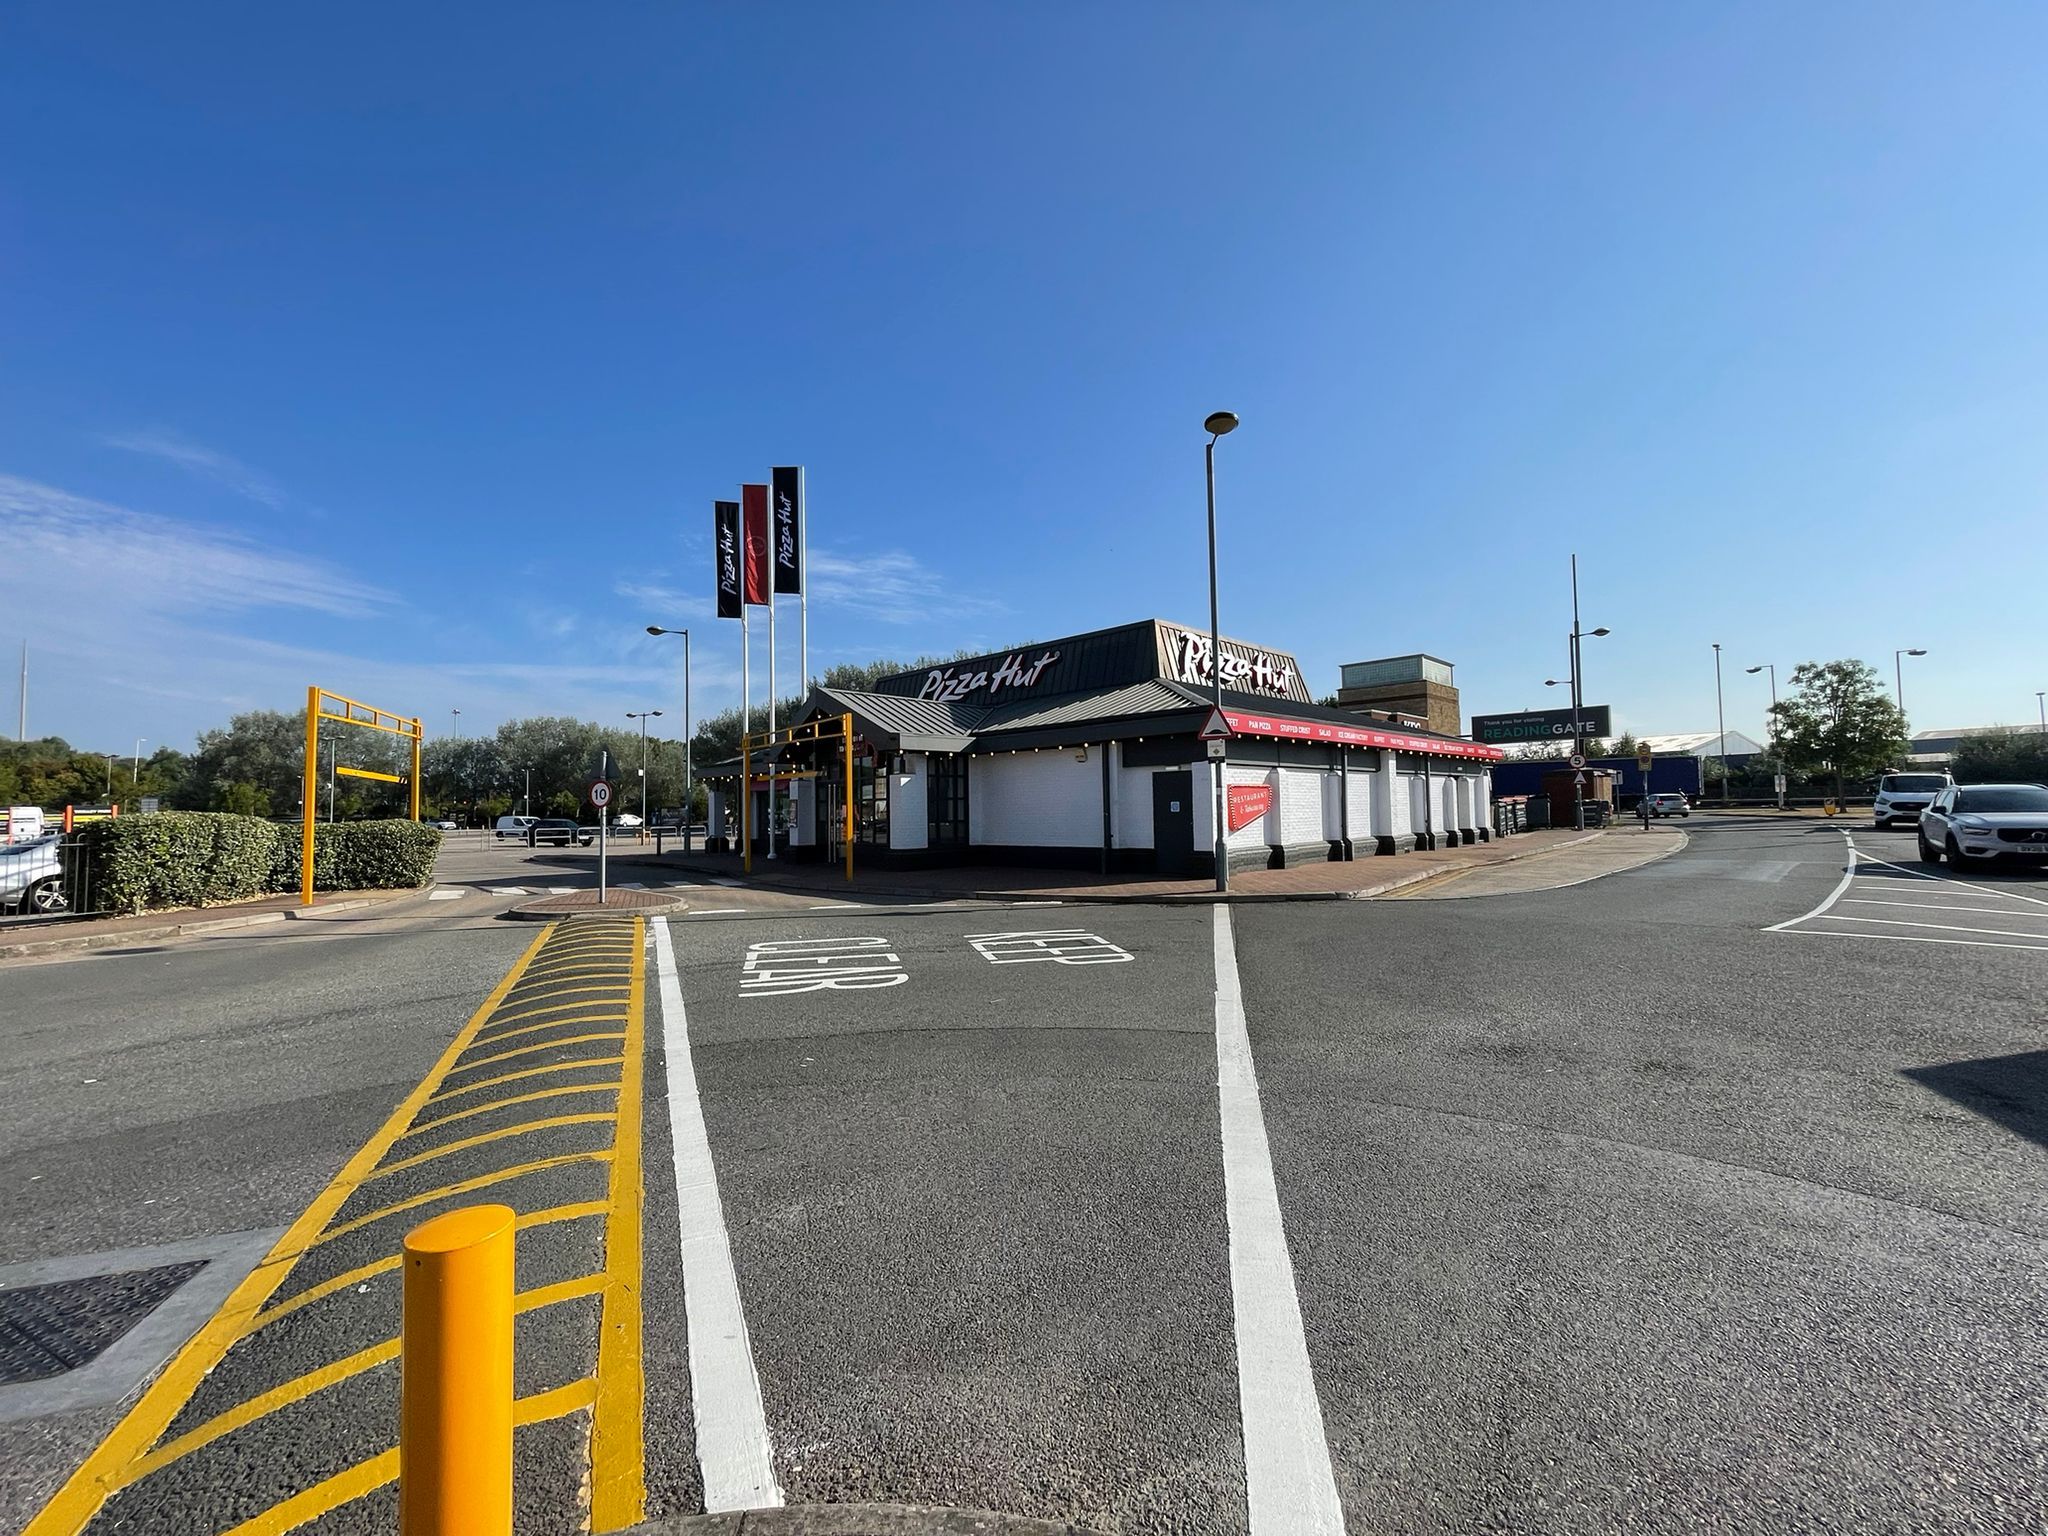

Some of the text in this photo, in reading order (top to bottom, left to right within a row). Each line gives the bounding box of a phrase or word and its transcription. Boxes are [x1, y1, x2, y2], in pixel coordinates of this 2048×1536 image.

[777, 491, 795, 569] Pizza Hut
[720, 523, 737, 595] Pizza Hut
[918, 651, 1057, 701] Pizza Hut
[1180, 631, 1296, 694] Pizza Hut
[1248, 720, 1259, 729] PAN
[1259, 721, 1272, 731] PIZZA
[1483, 721, 1596, 739] READING GATE
[1573, 757, 1581, 765] 5
[595, 789, 606, 800] 10
[1233, 791, 1267, 803] RESTAURANT
[963, 929, 1135, 965] KEEP
[738, 937, 910, 997] CLEAR
